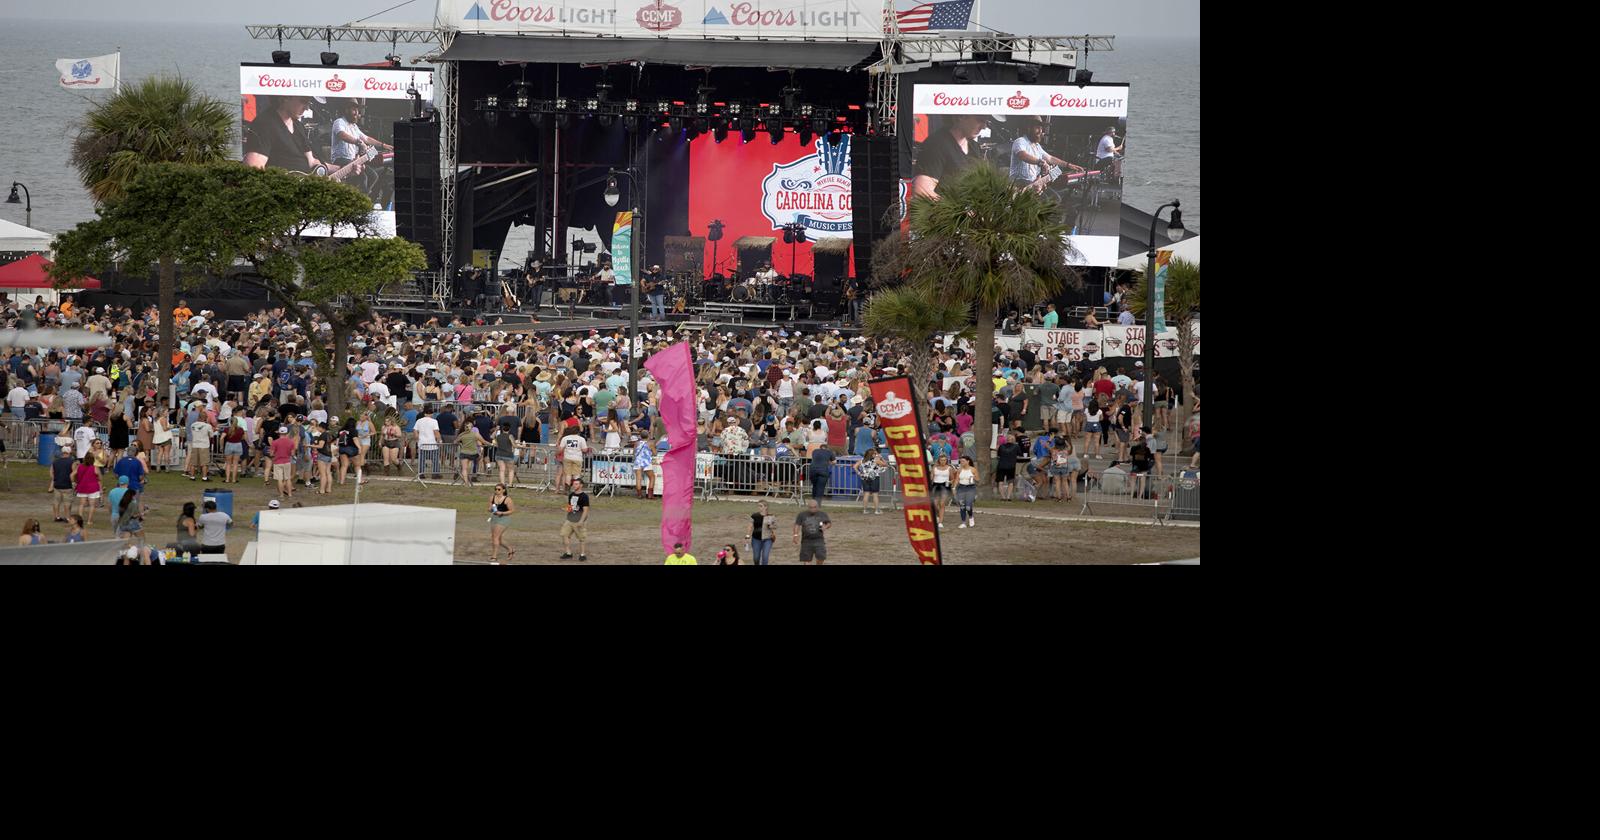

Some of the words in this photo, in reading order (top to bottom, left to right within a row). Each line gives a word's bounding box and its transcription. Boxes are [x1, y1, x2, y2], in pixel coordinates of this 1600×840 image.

[490, 0, 555, 22] Coors
[558, 8, 617, 24] LIGHT
[641, 9, 676, 22] CCMF
[730, 2, 798, 26] Coors
[800, 11, 860, 27] LIGHT
[258, 74, 292, 88] Coors
[293, 79, 322, 88] LIGHT
[364, 77, 398, 91] Coors
[933, 92, 970, 106] Coors
[971, 96, 1003, 106] LIGHT
[1049, 93, 1088, 108] Coors
[1089, 98, 1123, 108] LIGHT
[776, 190, 834, 210] CAROLINA
[808, 220, 836, 231] MUSIC
[1047, 331, 1080, 344] STAGE
[1046, 346, 1081, 361] BES
[1124, 343, 1160, 356] BOXS
[880, 401, 906, 413] CCMF
[884, 424, 928, 498] GOOD
[907, 508, 938, 566] EAT
